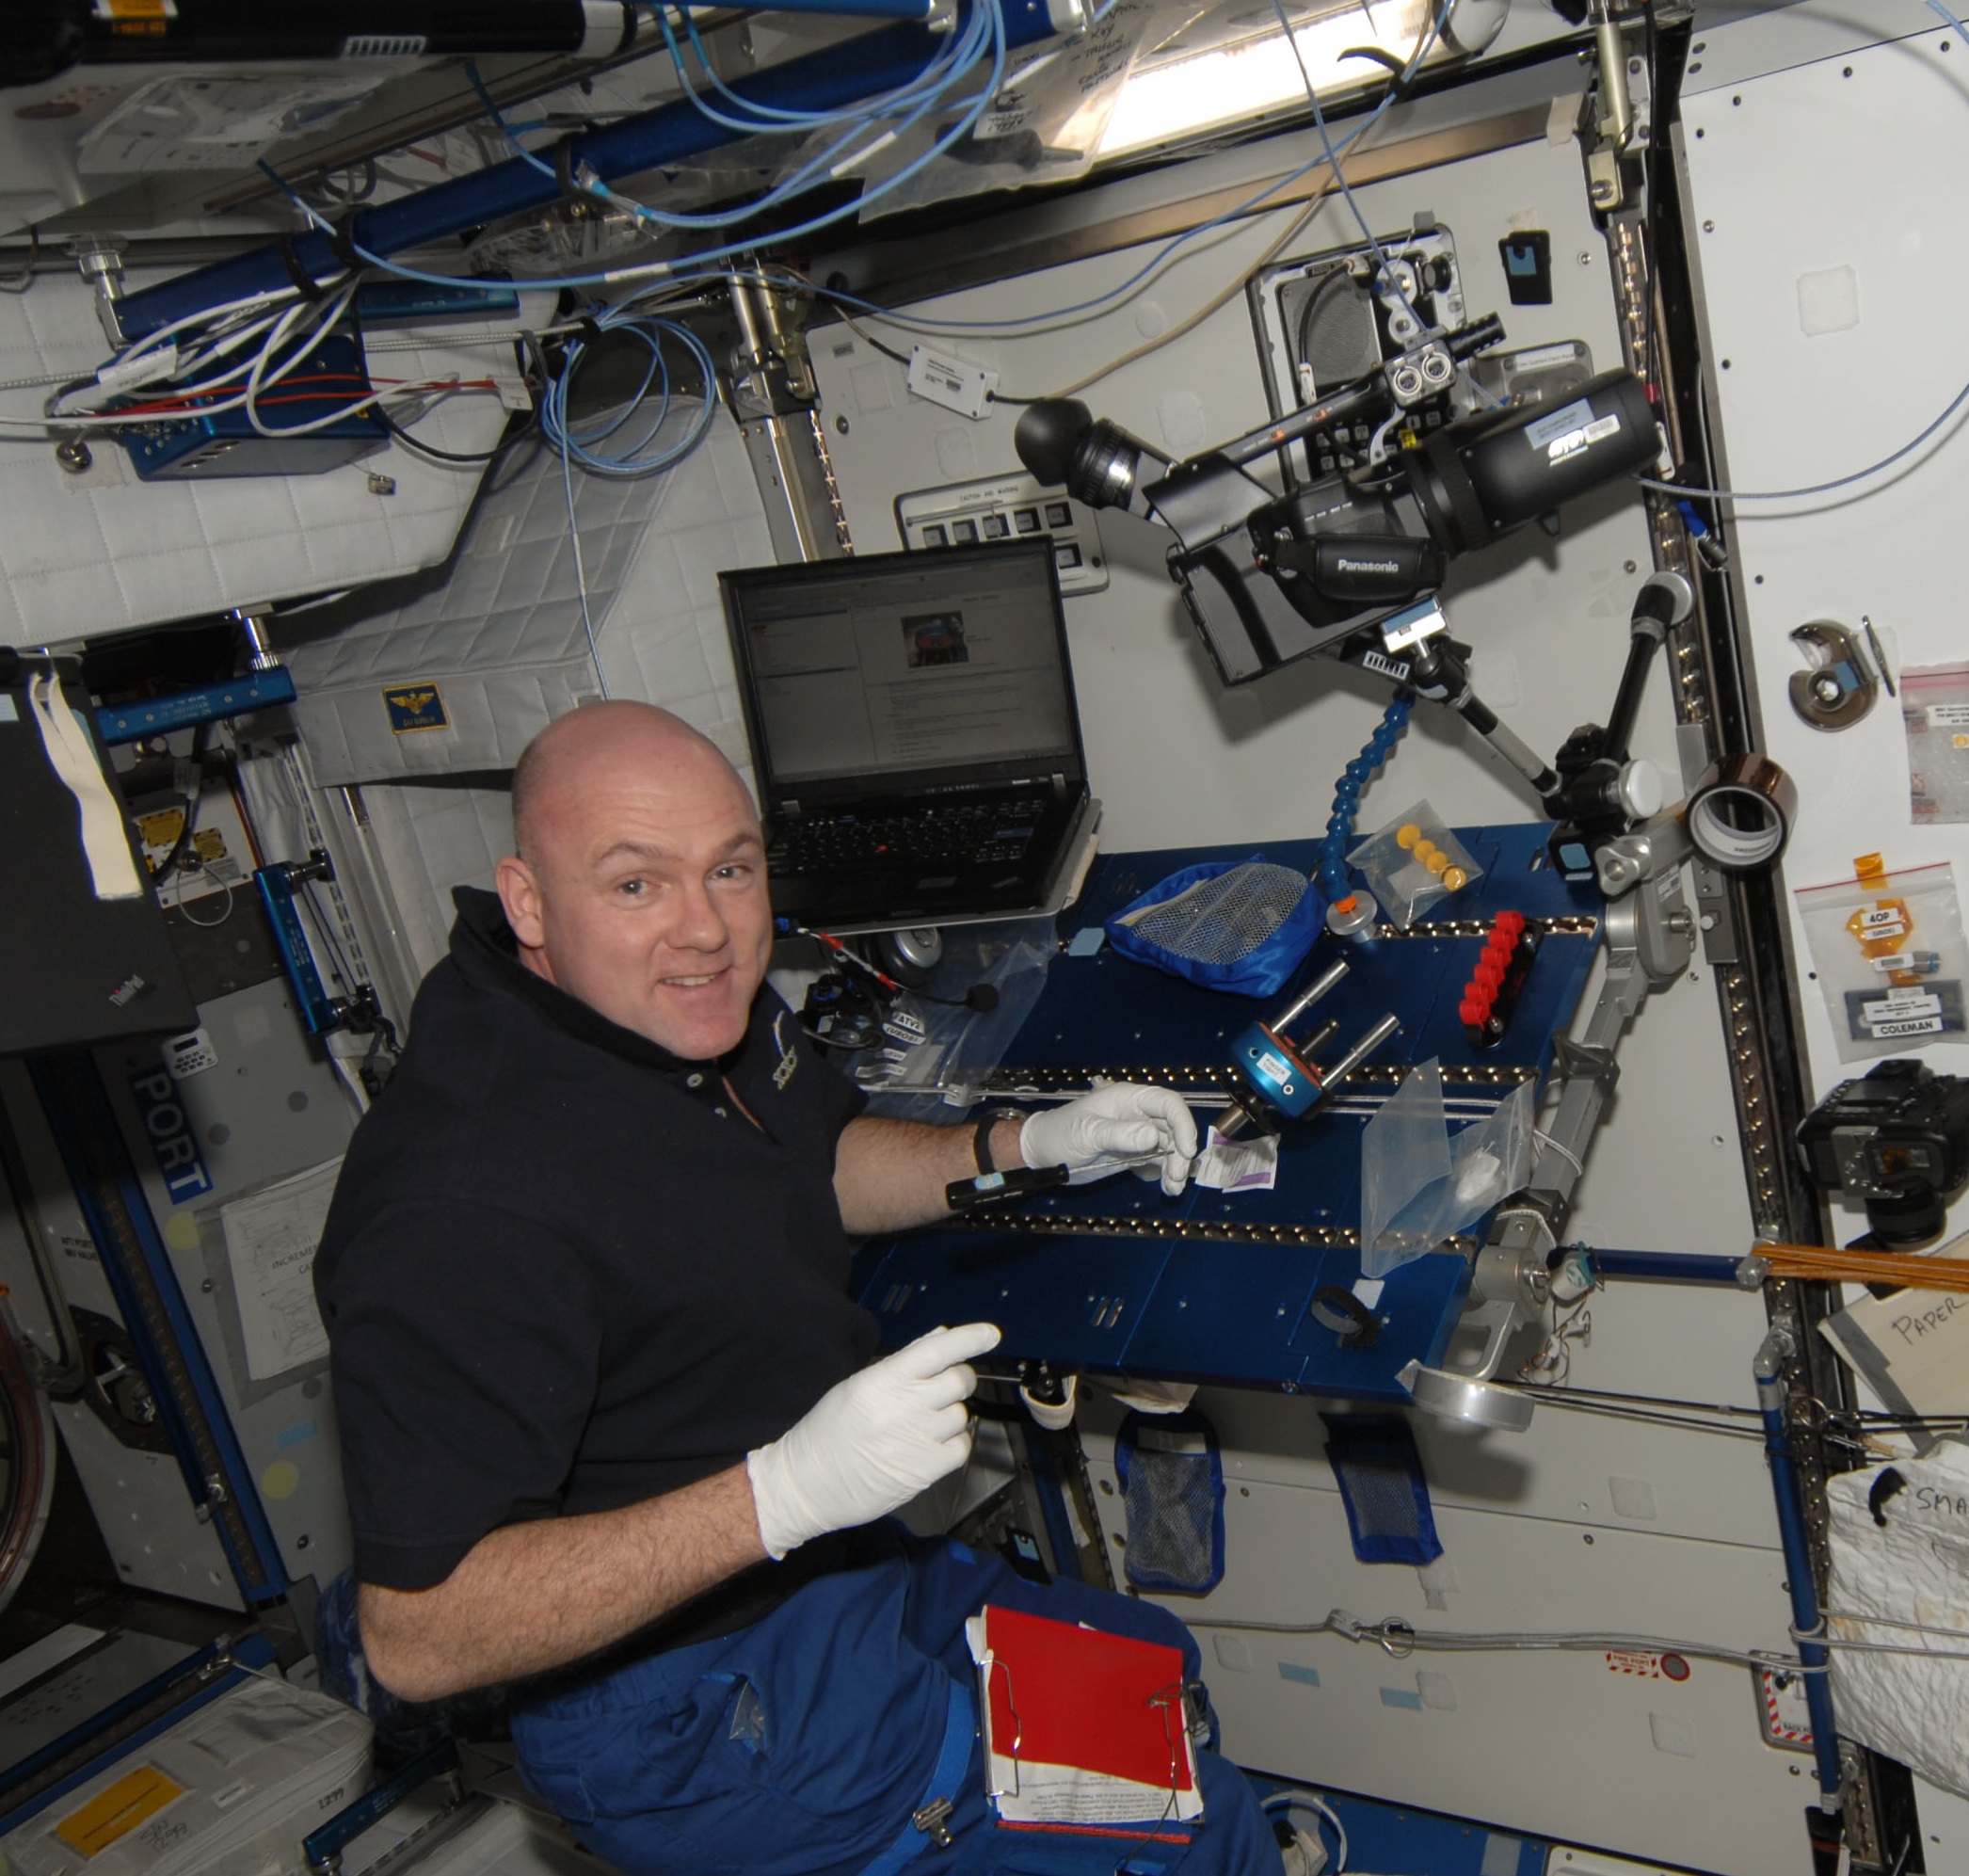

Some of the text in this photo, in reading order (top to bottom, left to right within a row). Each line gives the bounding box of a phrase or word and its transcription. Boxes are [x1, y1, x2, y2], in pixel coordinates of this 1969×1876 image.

[1337, 558, 1400, 573] Panasonic
[108, 973, 145, 1008] ThinkPad
[898, 1015, 920, 1030] ATV2
[1880, 1021, 1933, 1035] COLEMAN
[134, 1071, 207, 1190] PORT
[1891, 1296, 1969, 1346] PAPER
